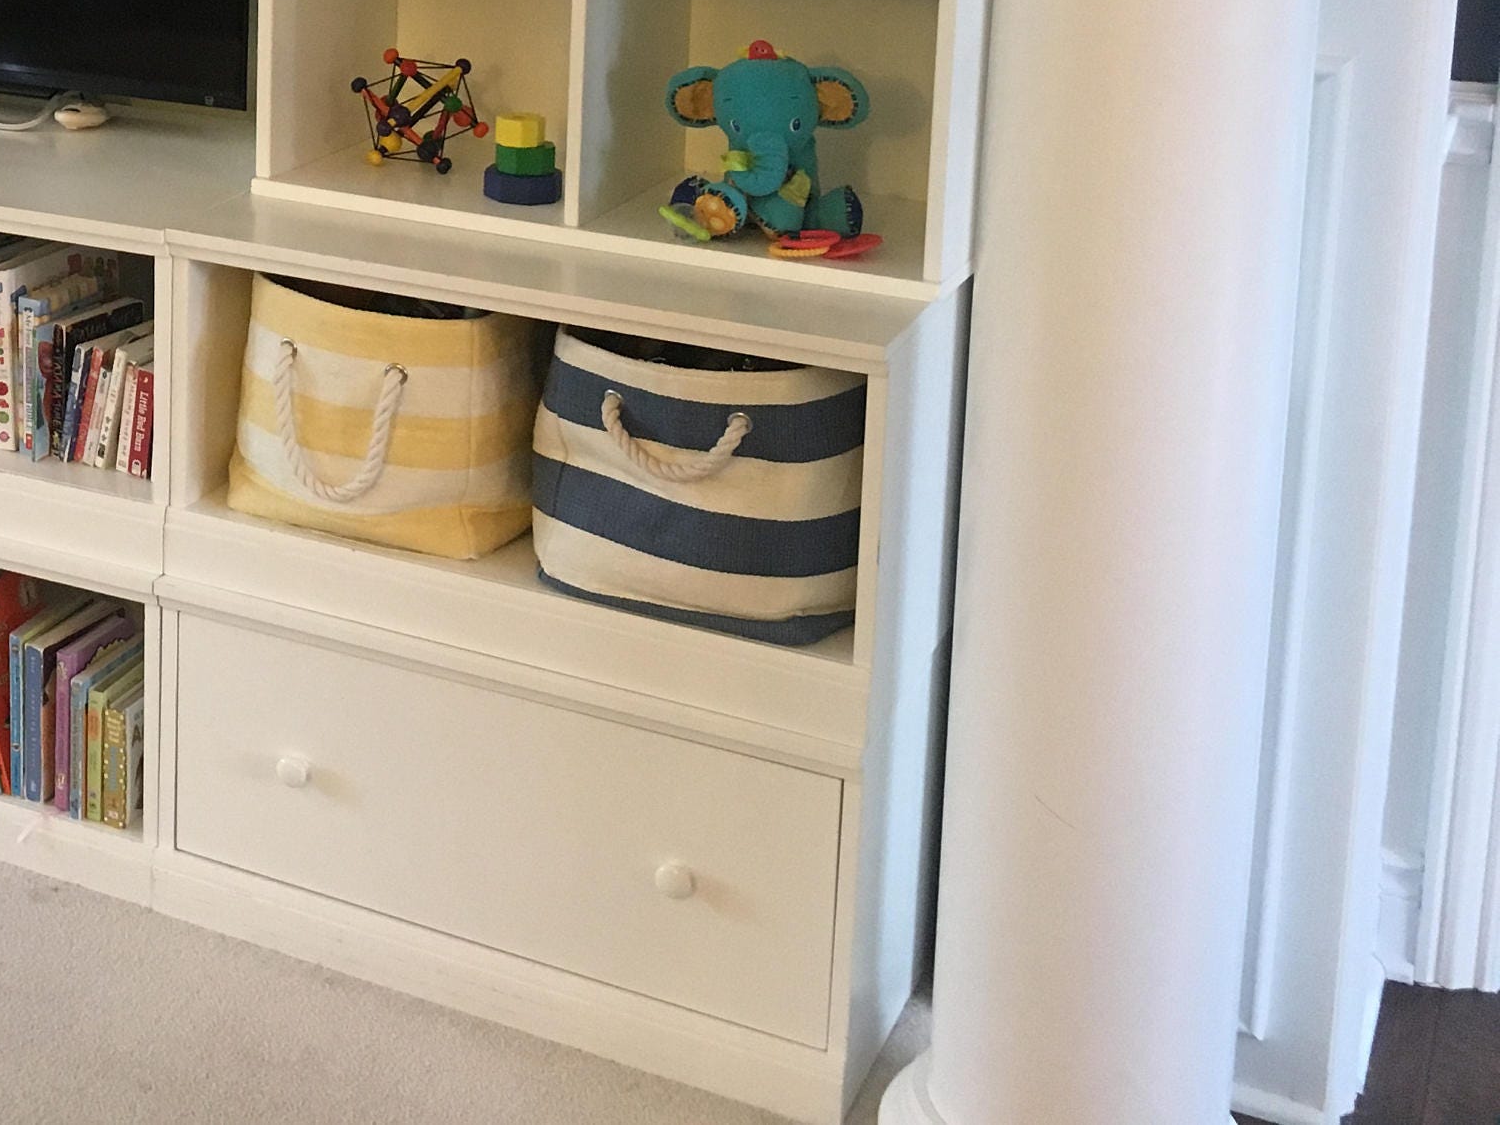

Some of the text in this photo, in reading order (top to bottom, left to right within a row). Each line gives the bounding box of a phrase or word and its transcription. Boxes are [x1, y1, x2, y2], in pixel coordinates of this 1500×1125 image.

[52, 355, 62, 398] PAJAMA
[134, 390, 148, 451] Little Red Barn
